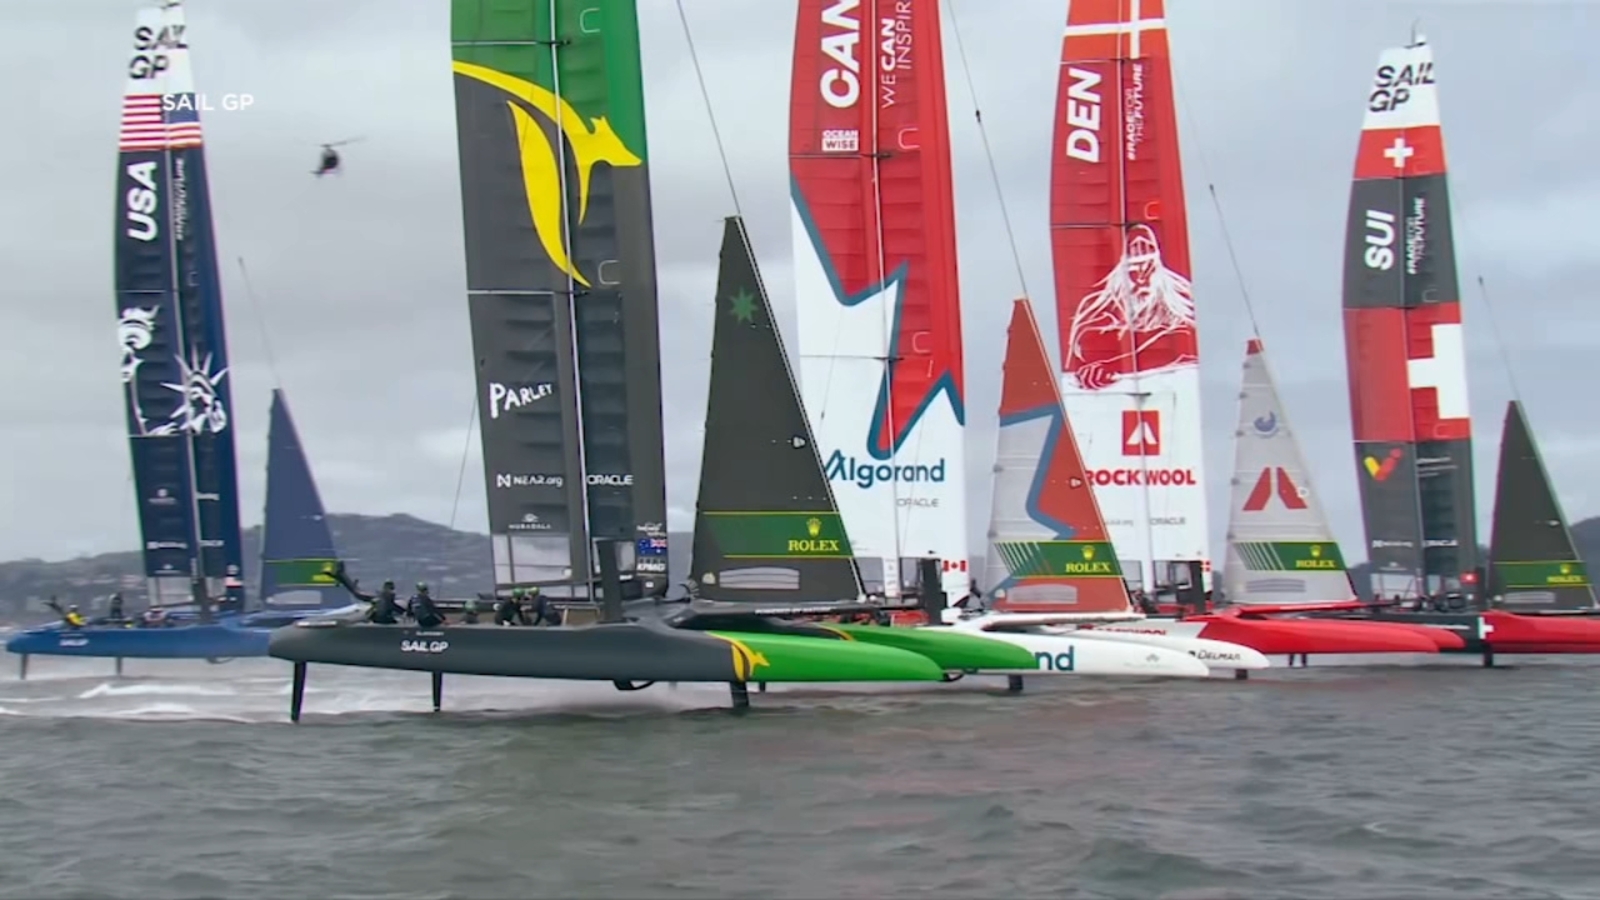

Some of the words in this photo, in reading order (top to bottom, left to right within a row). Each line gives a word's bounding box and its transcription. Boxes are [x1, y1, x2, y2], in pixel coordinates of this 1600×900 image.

[820, 0, 860, 109] CAN
[881, 18, 896, 71] CAN
[128, 54, 170, 80] GP
[1375, 62, 1437, 88] SAIL
[881, 74, 896, 109] WE
[1369, 88, 1411, 113] GP
[1066, 66, 1103, 164] DEN
[825, 140, 857, 149] WISE
[127, 161, 159, 242] USA
[1365, 210, 1396, 271] SUI
[489, 382, 553, 419] PARLEY
[587, 475, 634, 486] ORACLE
[824, 449, 945, 489] Algorand
[896, 497, 940, 509] ORACLE
[788, 540, 840, 552] ROLEX
[1065, 562, 1112, 573] ROLEX
[1295, 560, 1336, 569] ROLEX
